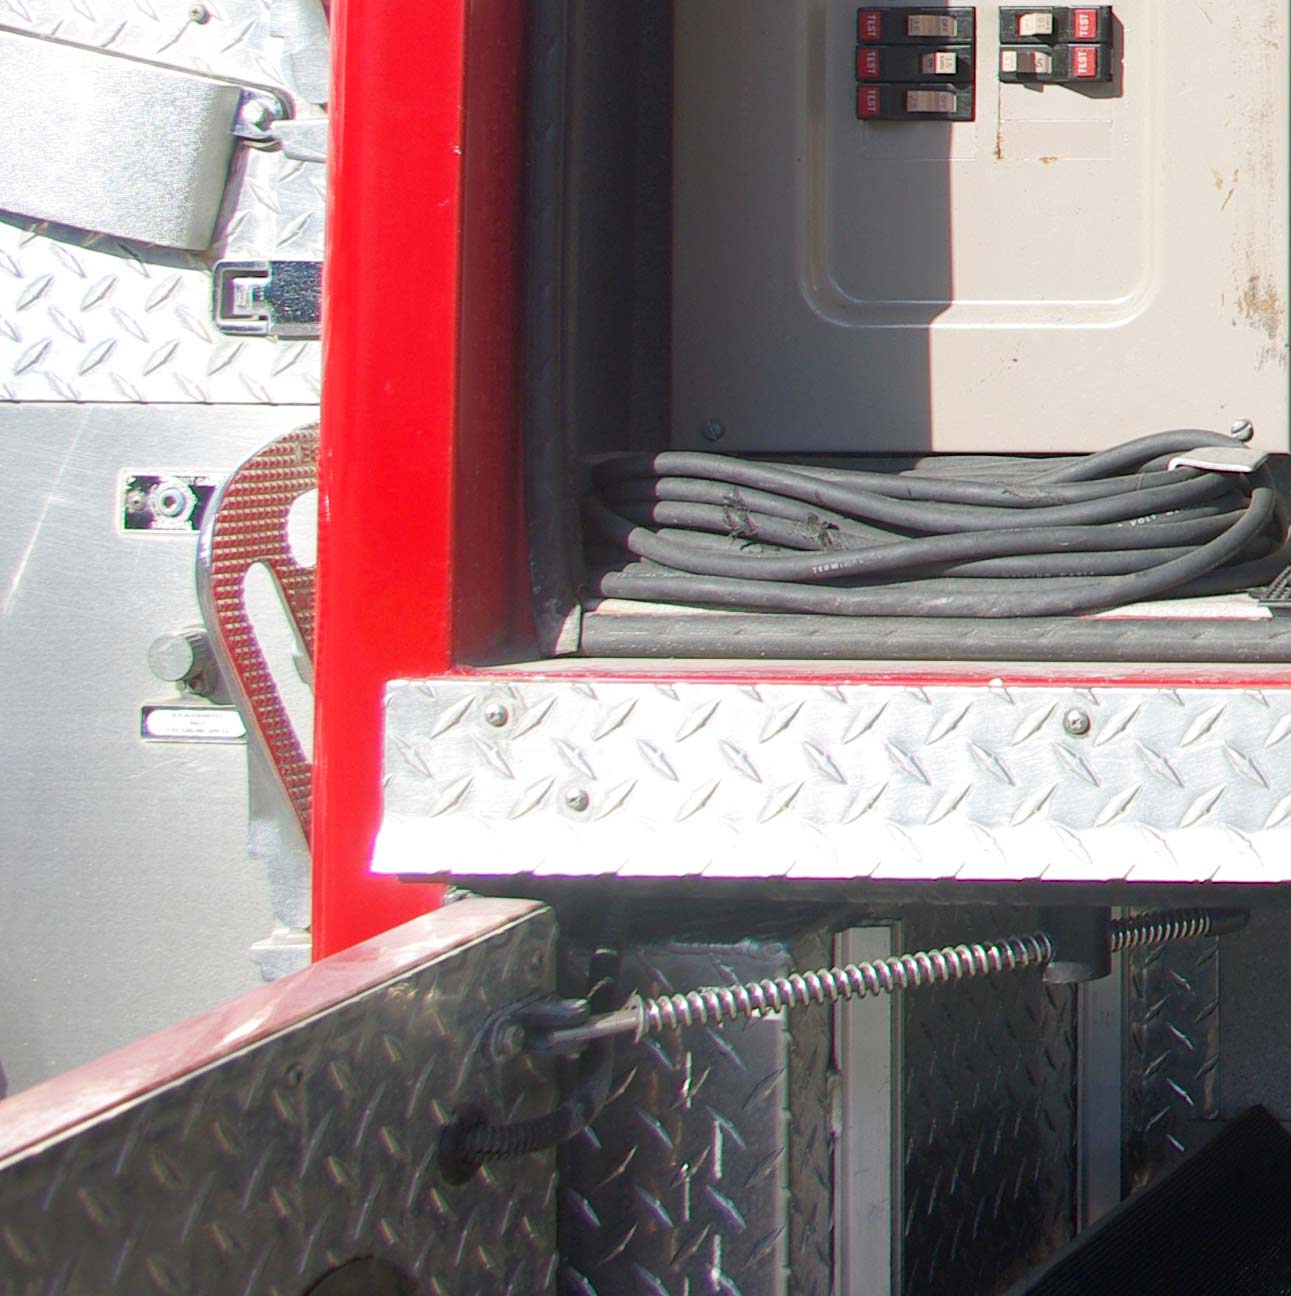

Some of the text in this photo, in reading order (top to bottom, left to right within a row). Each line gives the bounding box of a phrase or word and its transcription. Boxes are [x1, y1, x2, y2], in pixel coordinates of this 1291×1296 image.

[866, 14, 877, 37] TEST
[1079, 13, 1089, 37] TEST
[866, 52, 877, 73] TEST
[1077, 51, 1088, 74] TEST
[866, 90, 877, 112] TEST
